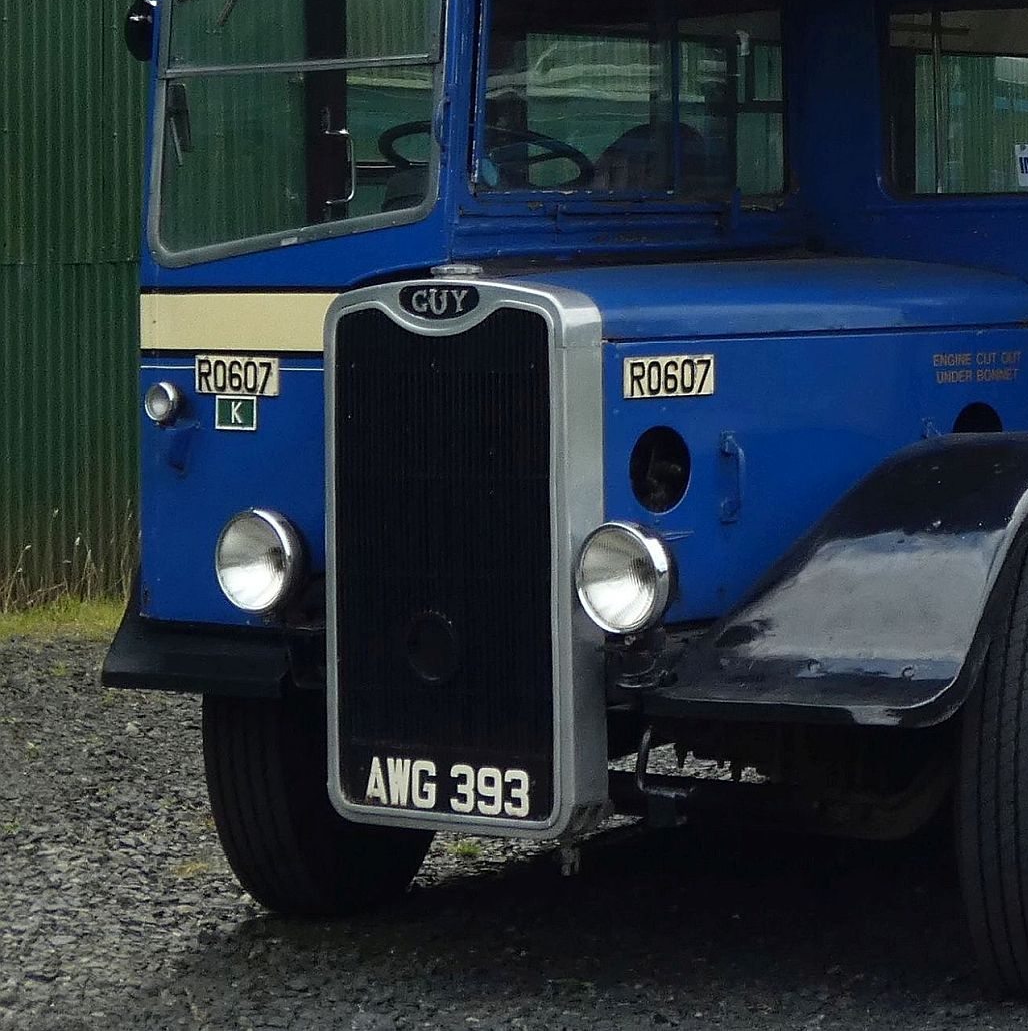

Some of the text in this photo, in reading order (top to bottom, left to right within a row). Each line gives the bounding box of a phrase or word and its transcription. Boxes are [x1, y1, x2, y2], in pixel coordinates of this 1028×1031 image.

[411, 288, 469, 315] GUY
[933, 352, 973, 367] ENGINE
[976, 352, 997, 365] CUT
[936, 369, 973, 384] UNDER
[231, 401, 243, 424] K
[365, 755, 530, 817] AWG 393
